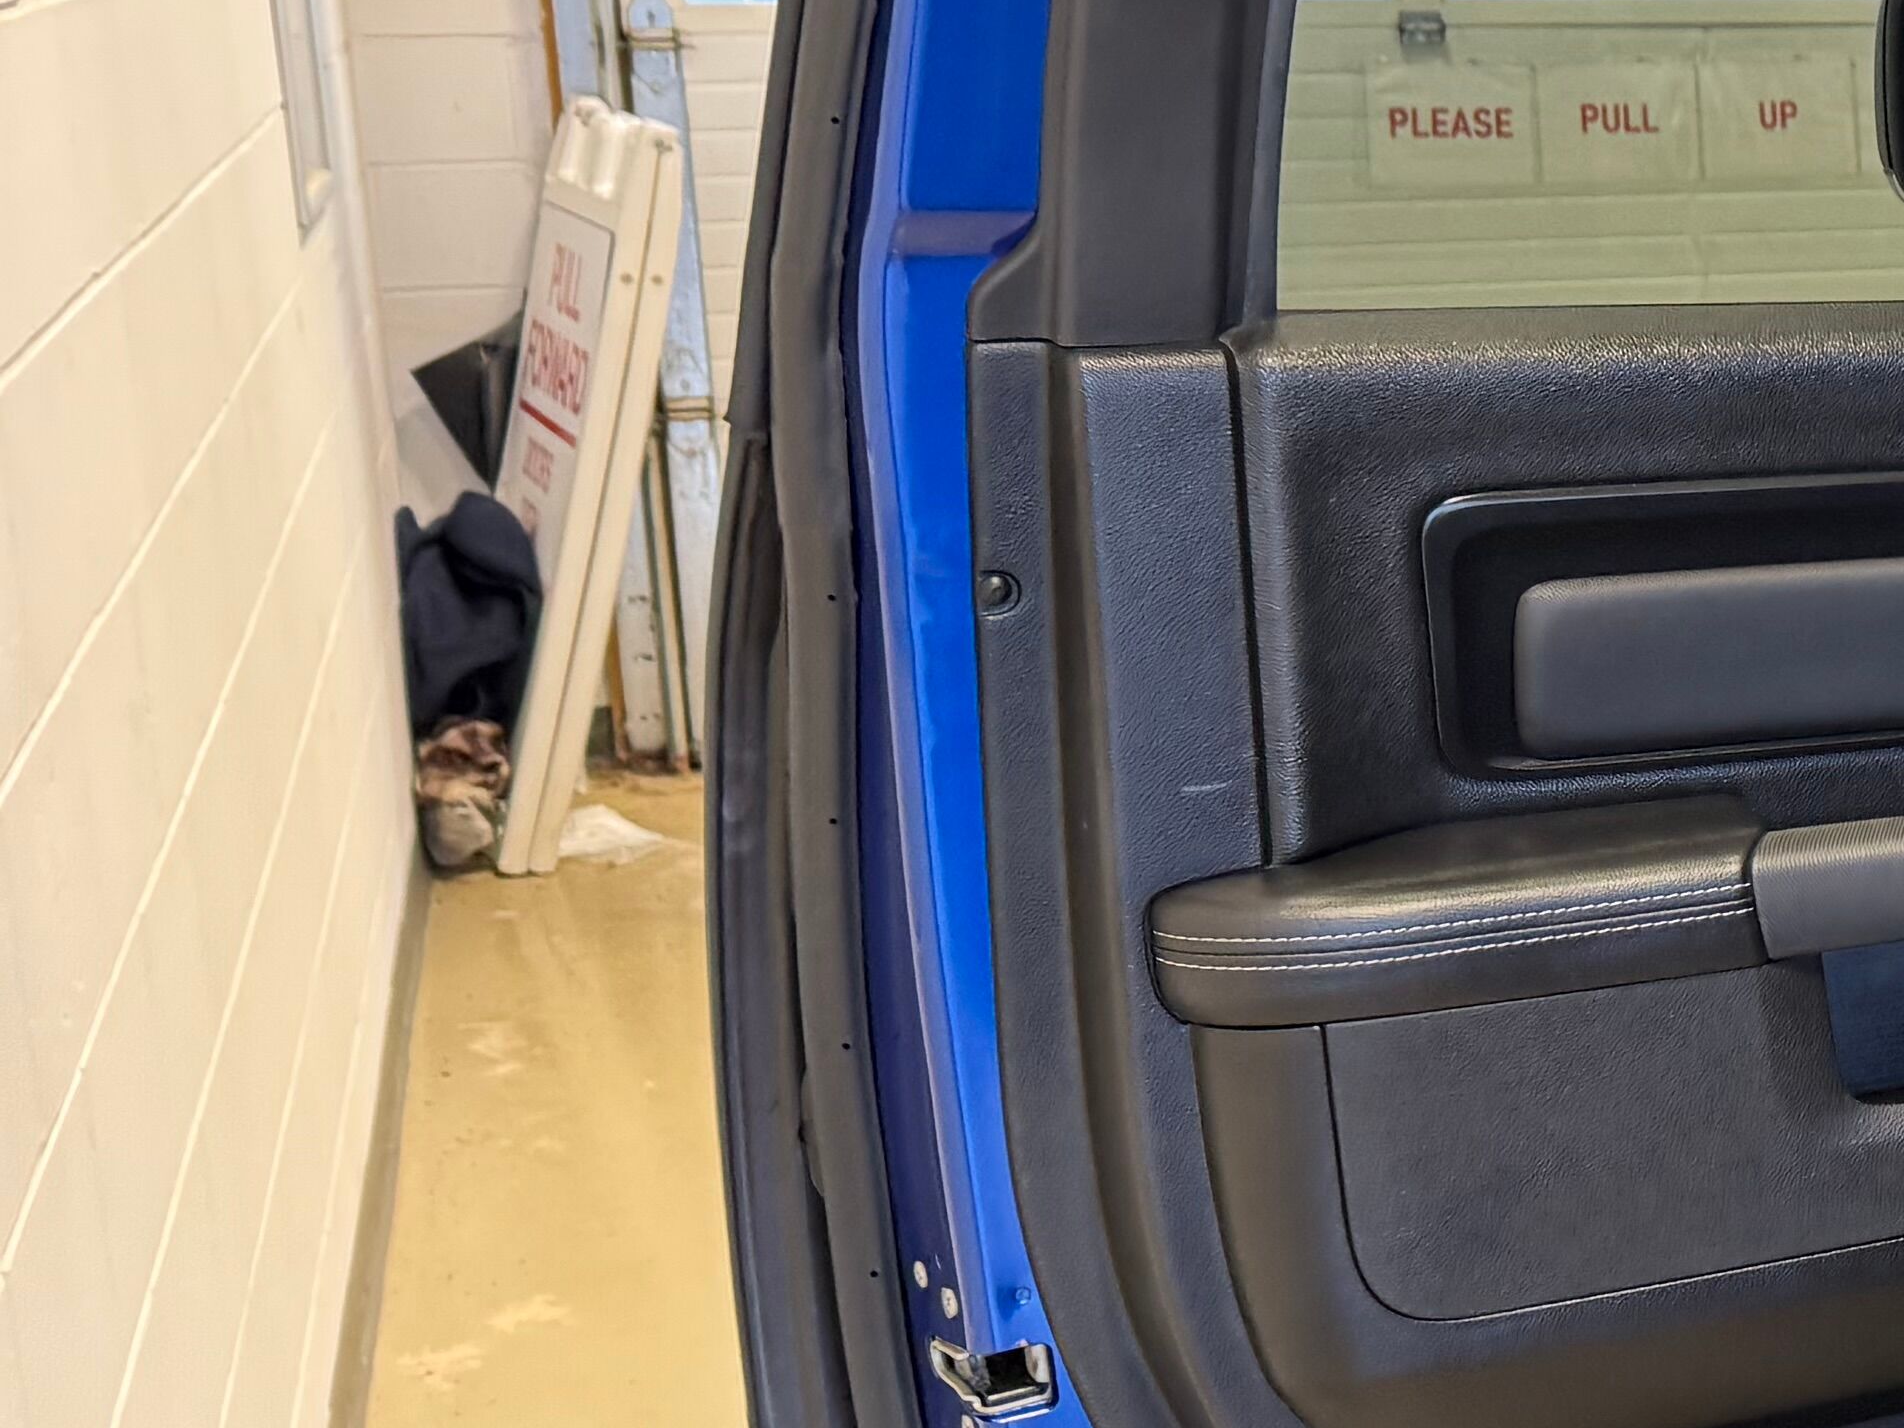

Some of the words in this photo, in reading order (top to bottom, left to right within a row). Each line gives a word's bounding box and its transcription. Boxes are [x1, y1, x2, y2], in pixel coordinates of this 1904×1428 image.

[1387, 106, 1514, 140] PLEASE
[1580, 102, 1660, 135] PULL
[1758, 99, 1799, 130] UP
[547, 240, 583, 322] PULL
[519, 318, 590, 416] FORWARD
